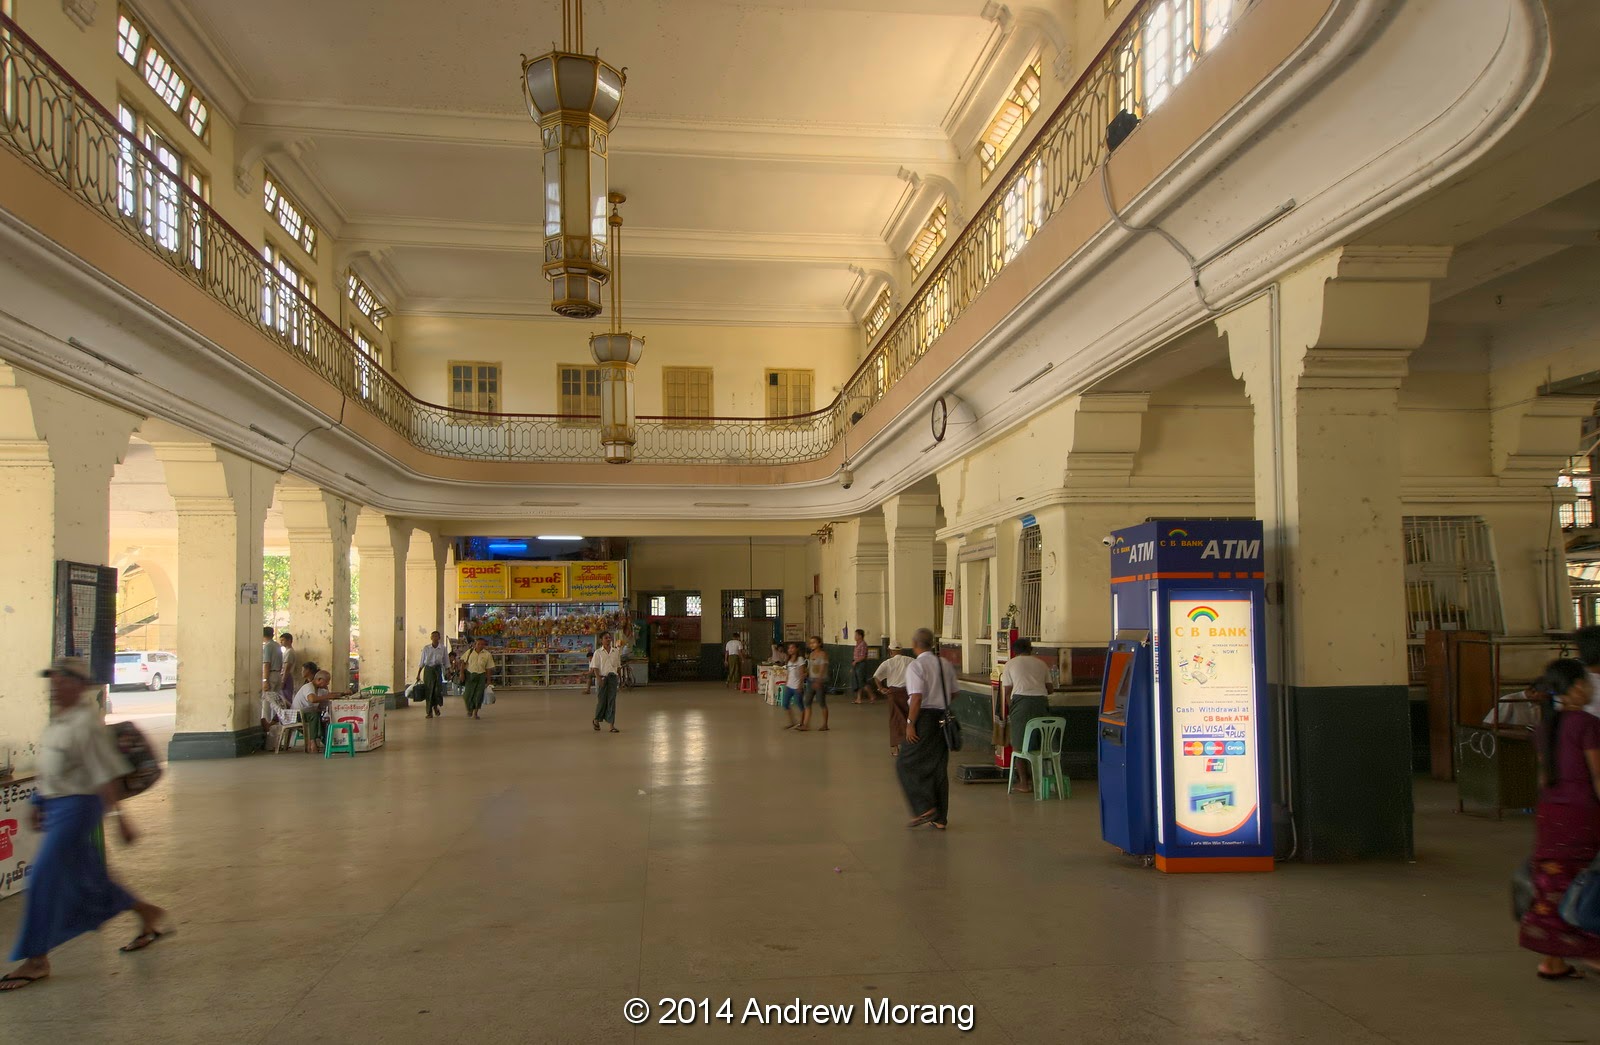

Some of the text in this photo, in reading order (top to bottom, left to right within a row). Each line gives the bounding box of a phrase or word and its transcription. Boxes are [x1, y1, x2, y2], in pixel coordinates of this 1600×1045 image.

[1128, 541, 1155, 564] ATM
[1201, 540, 1260, 559] ATM
[1174, 627, 1247, 637] C B BANK
[1183, 725, 1246, 738] VISA VISA PLUS
